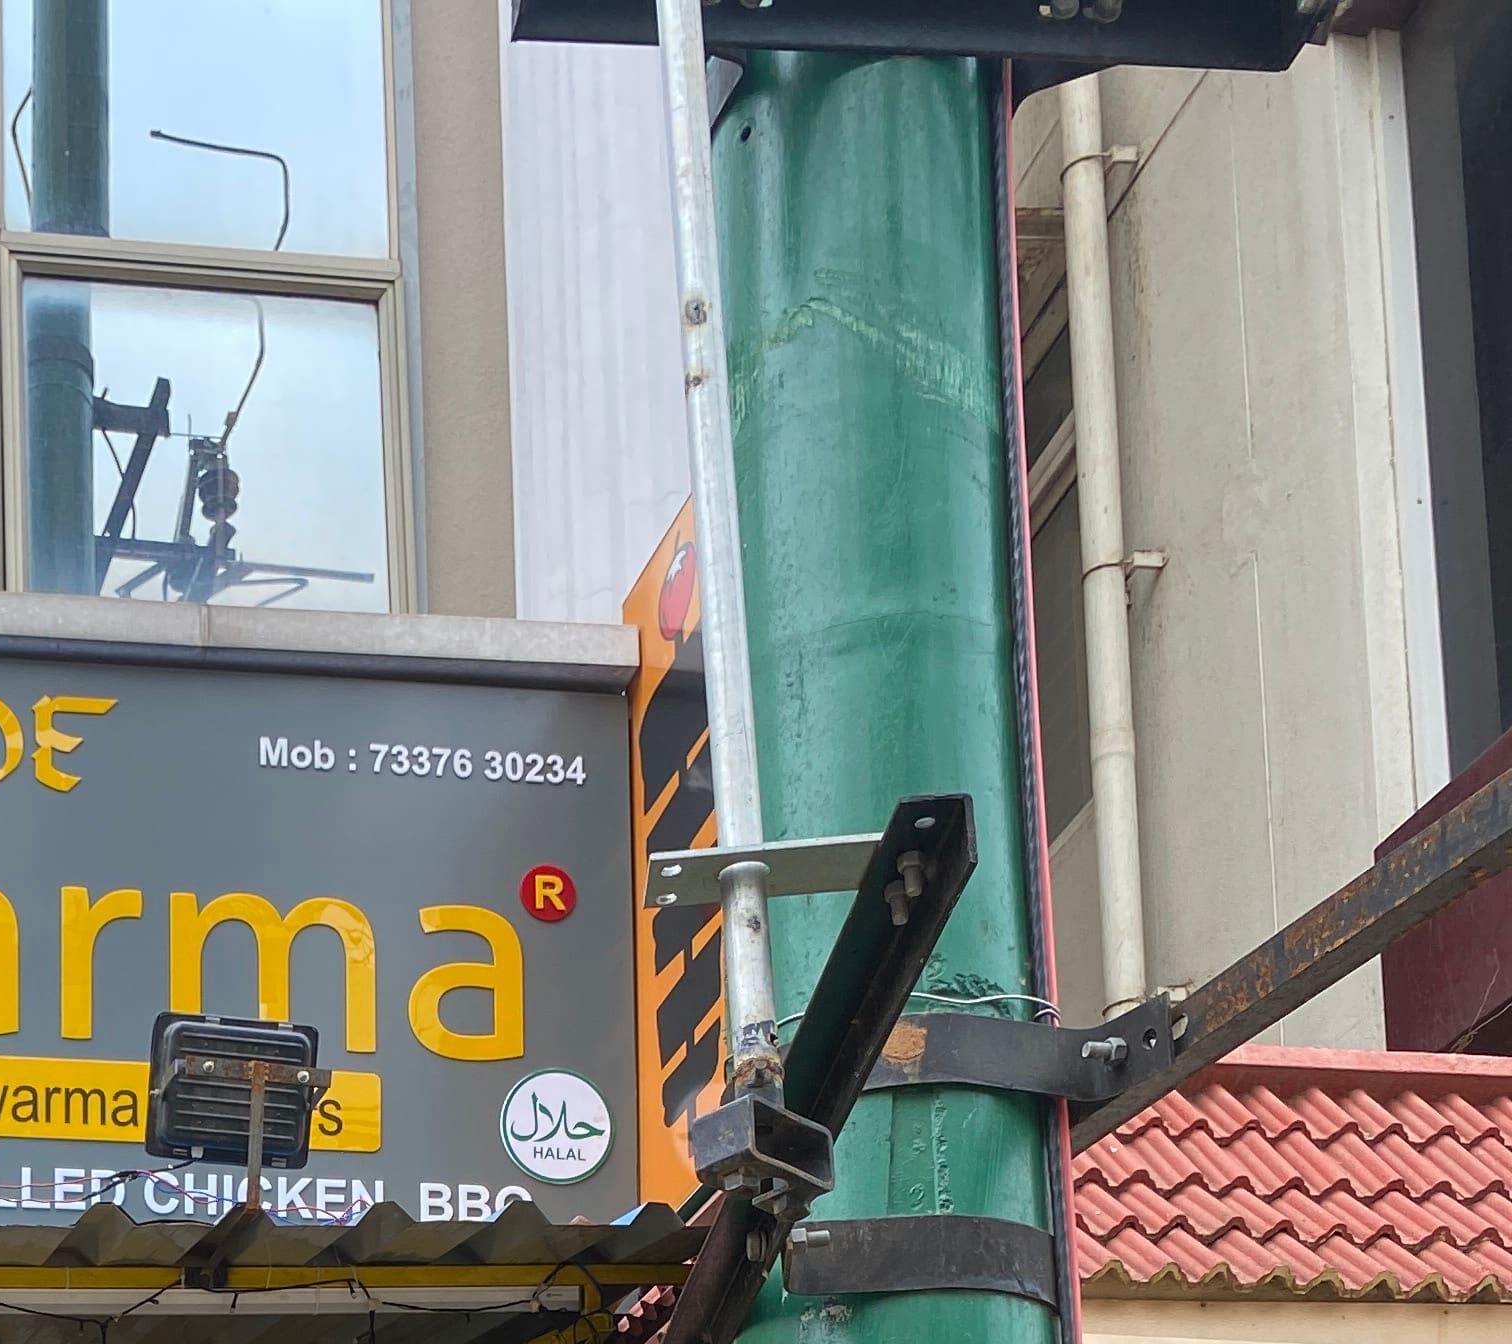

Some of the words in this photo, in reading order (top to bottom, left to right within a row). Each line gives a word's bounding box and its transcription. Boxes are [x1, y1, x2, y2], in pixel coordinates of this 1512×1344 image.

[258, 736, 335, 771] Mob
[369, 743, 473, 778] 73376
[484, 751, 586, 786] 30234
[510, 1092, 606, 1143] حلال
[533, 1146, 587, 1162] HALAL
[144, 1171, 384, 1223] CHICKEN
